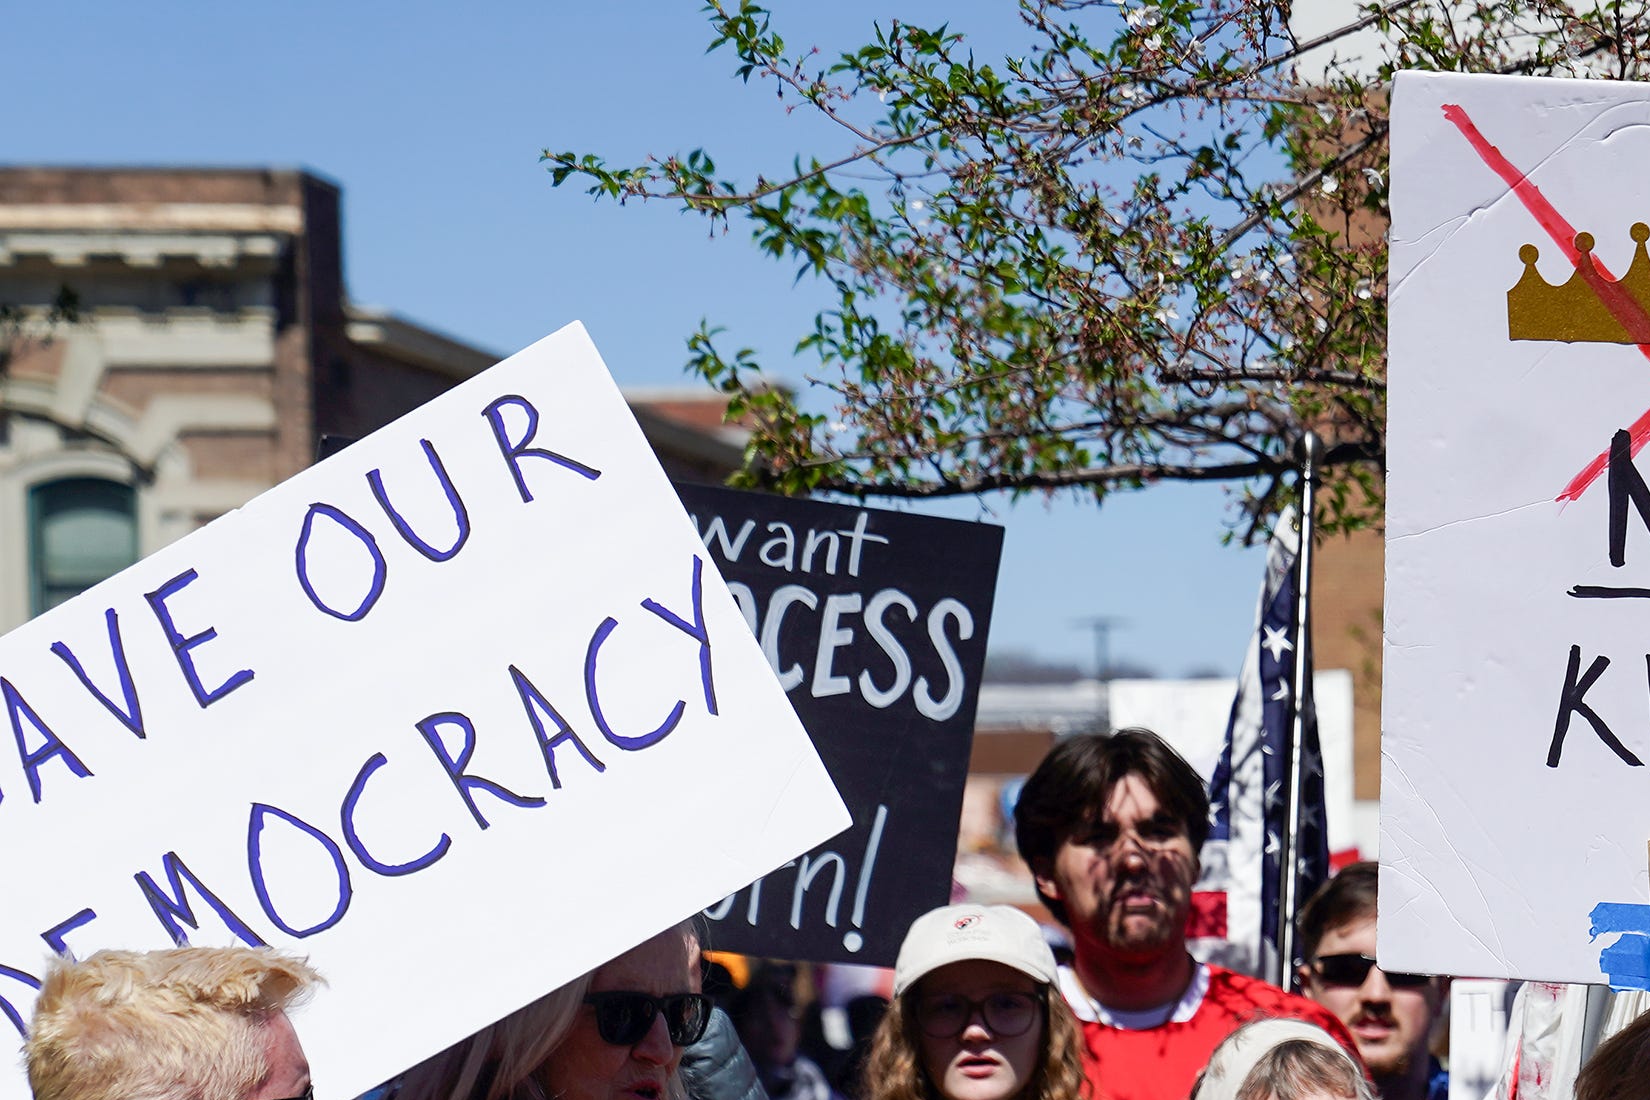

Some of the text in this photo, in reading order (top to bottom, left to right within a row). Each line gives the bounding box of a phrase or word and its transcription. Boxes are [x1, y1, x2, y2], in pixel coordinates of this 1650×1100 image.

[0, 394, 602, 803] AVE OUR
[690, 511, 889, 577] want
